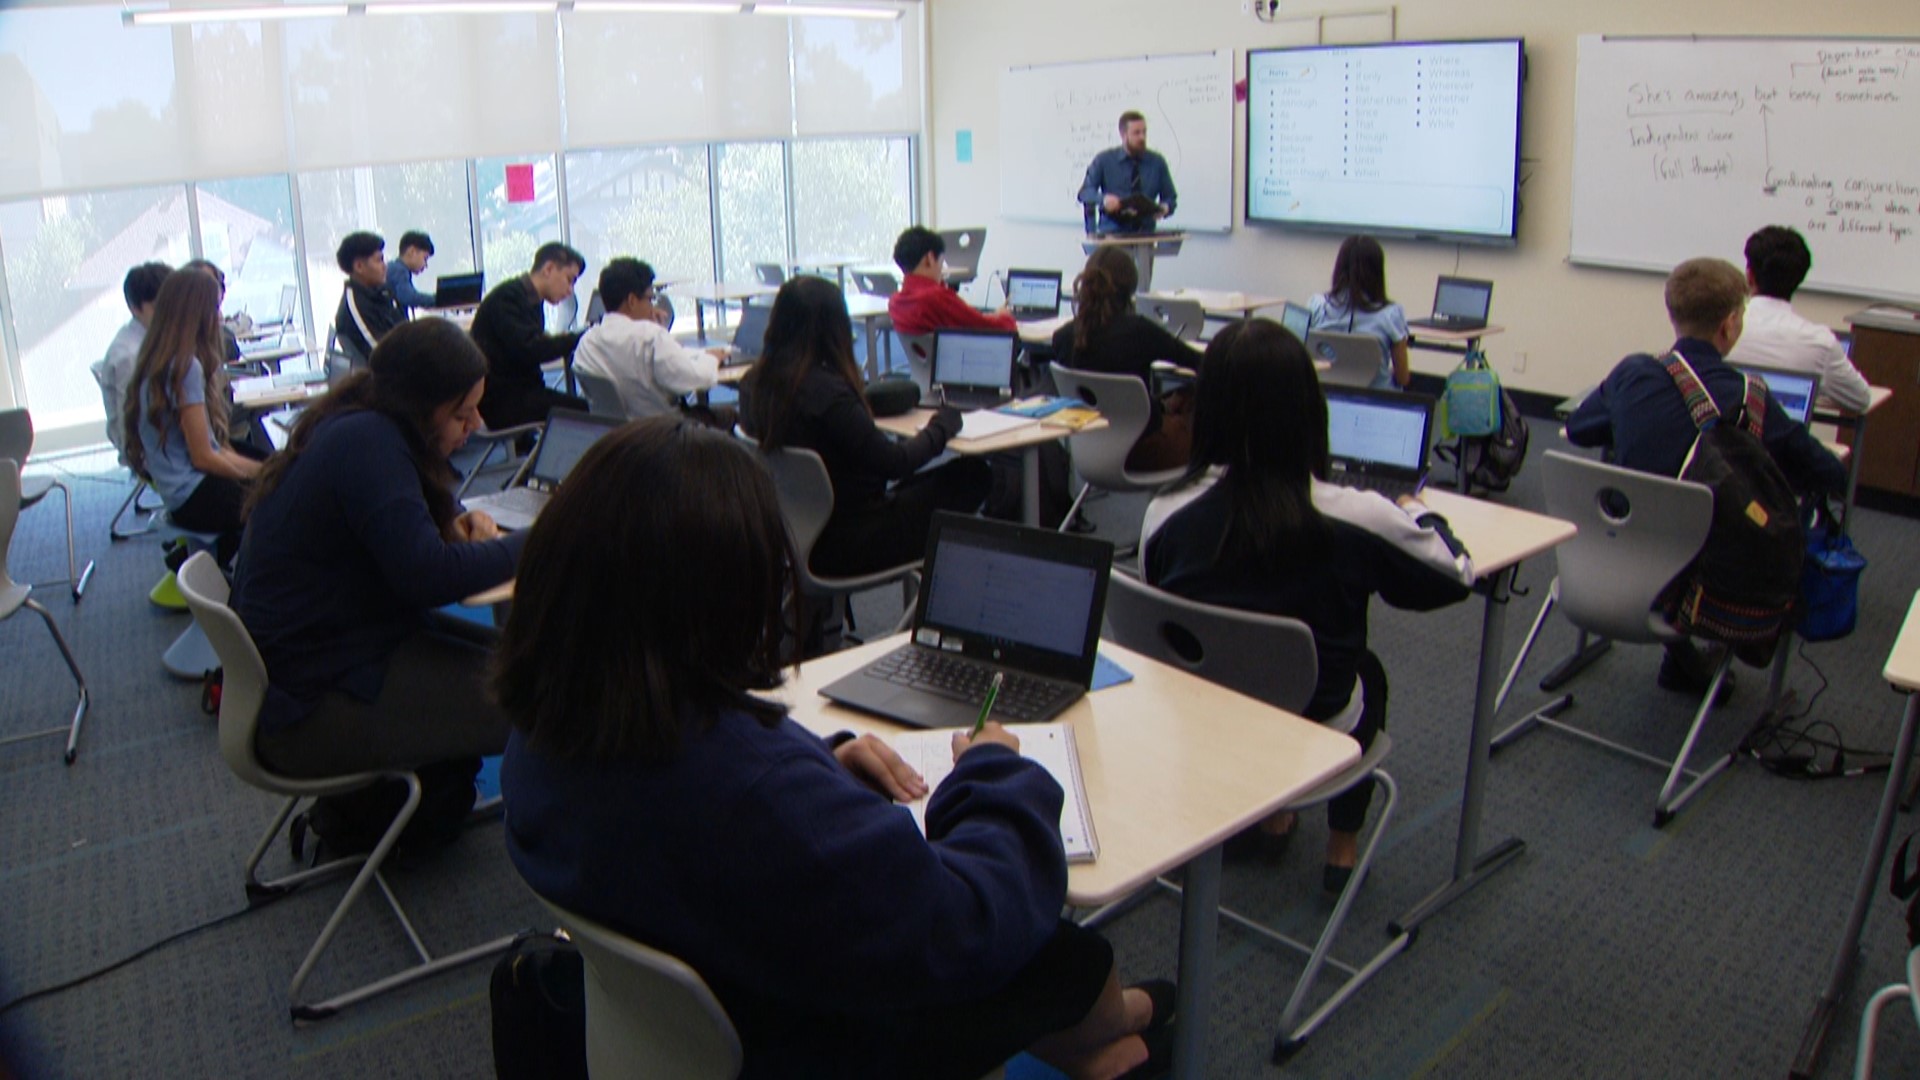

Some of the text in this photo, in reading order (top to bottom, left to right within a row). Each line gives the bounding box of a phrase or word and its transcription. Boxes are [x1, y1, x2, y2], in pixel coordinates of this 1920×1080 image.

[1429, 56, 1461, 66] Where
[1429, 69, 1471, 78] Whereas
[1429, 81, 1474, 91] Wherever
[1628, 81, 1672, 104] She's
[1755, 84, 1777, 101] but
[1355, 95, 1408, 105] Rather than
[1428, 94, 1470, 103] Whether
[1428, 106, 1459, 116] Which
[1428, 118, 1455, 128] While
[1355, 131, 1388, 143] Though
[1354, 168, 1380, 177] When
[1805, 195, 1814, 207] a
[1828, 197, 1872, 212] comma
[1885, 200, 1910, 214] when
[1808, 218, 1827, 231] are
[1839, 217, 1882, 233] different
